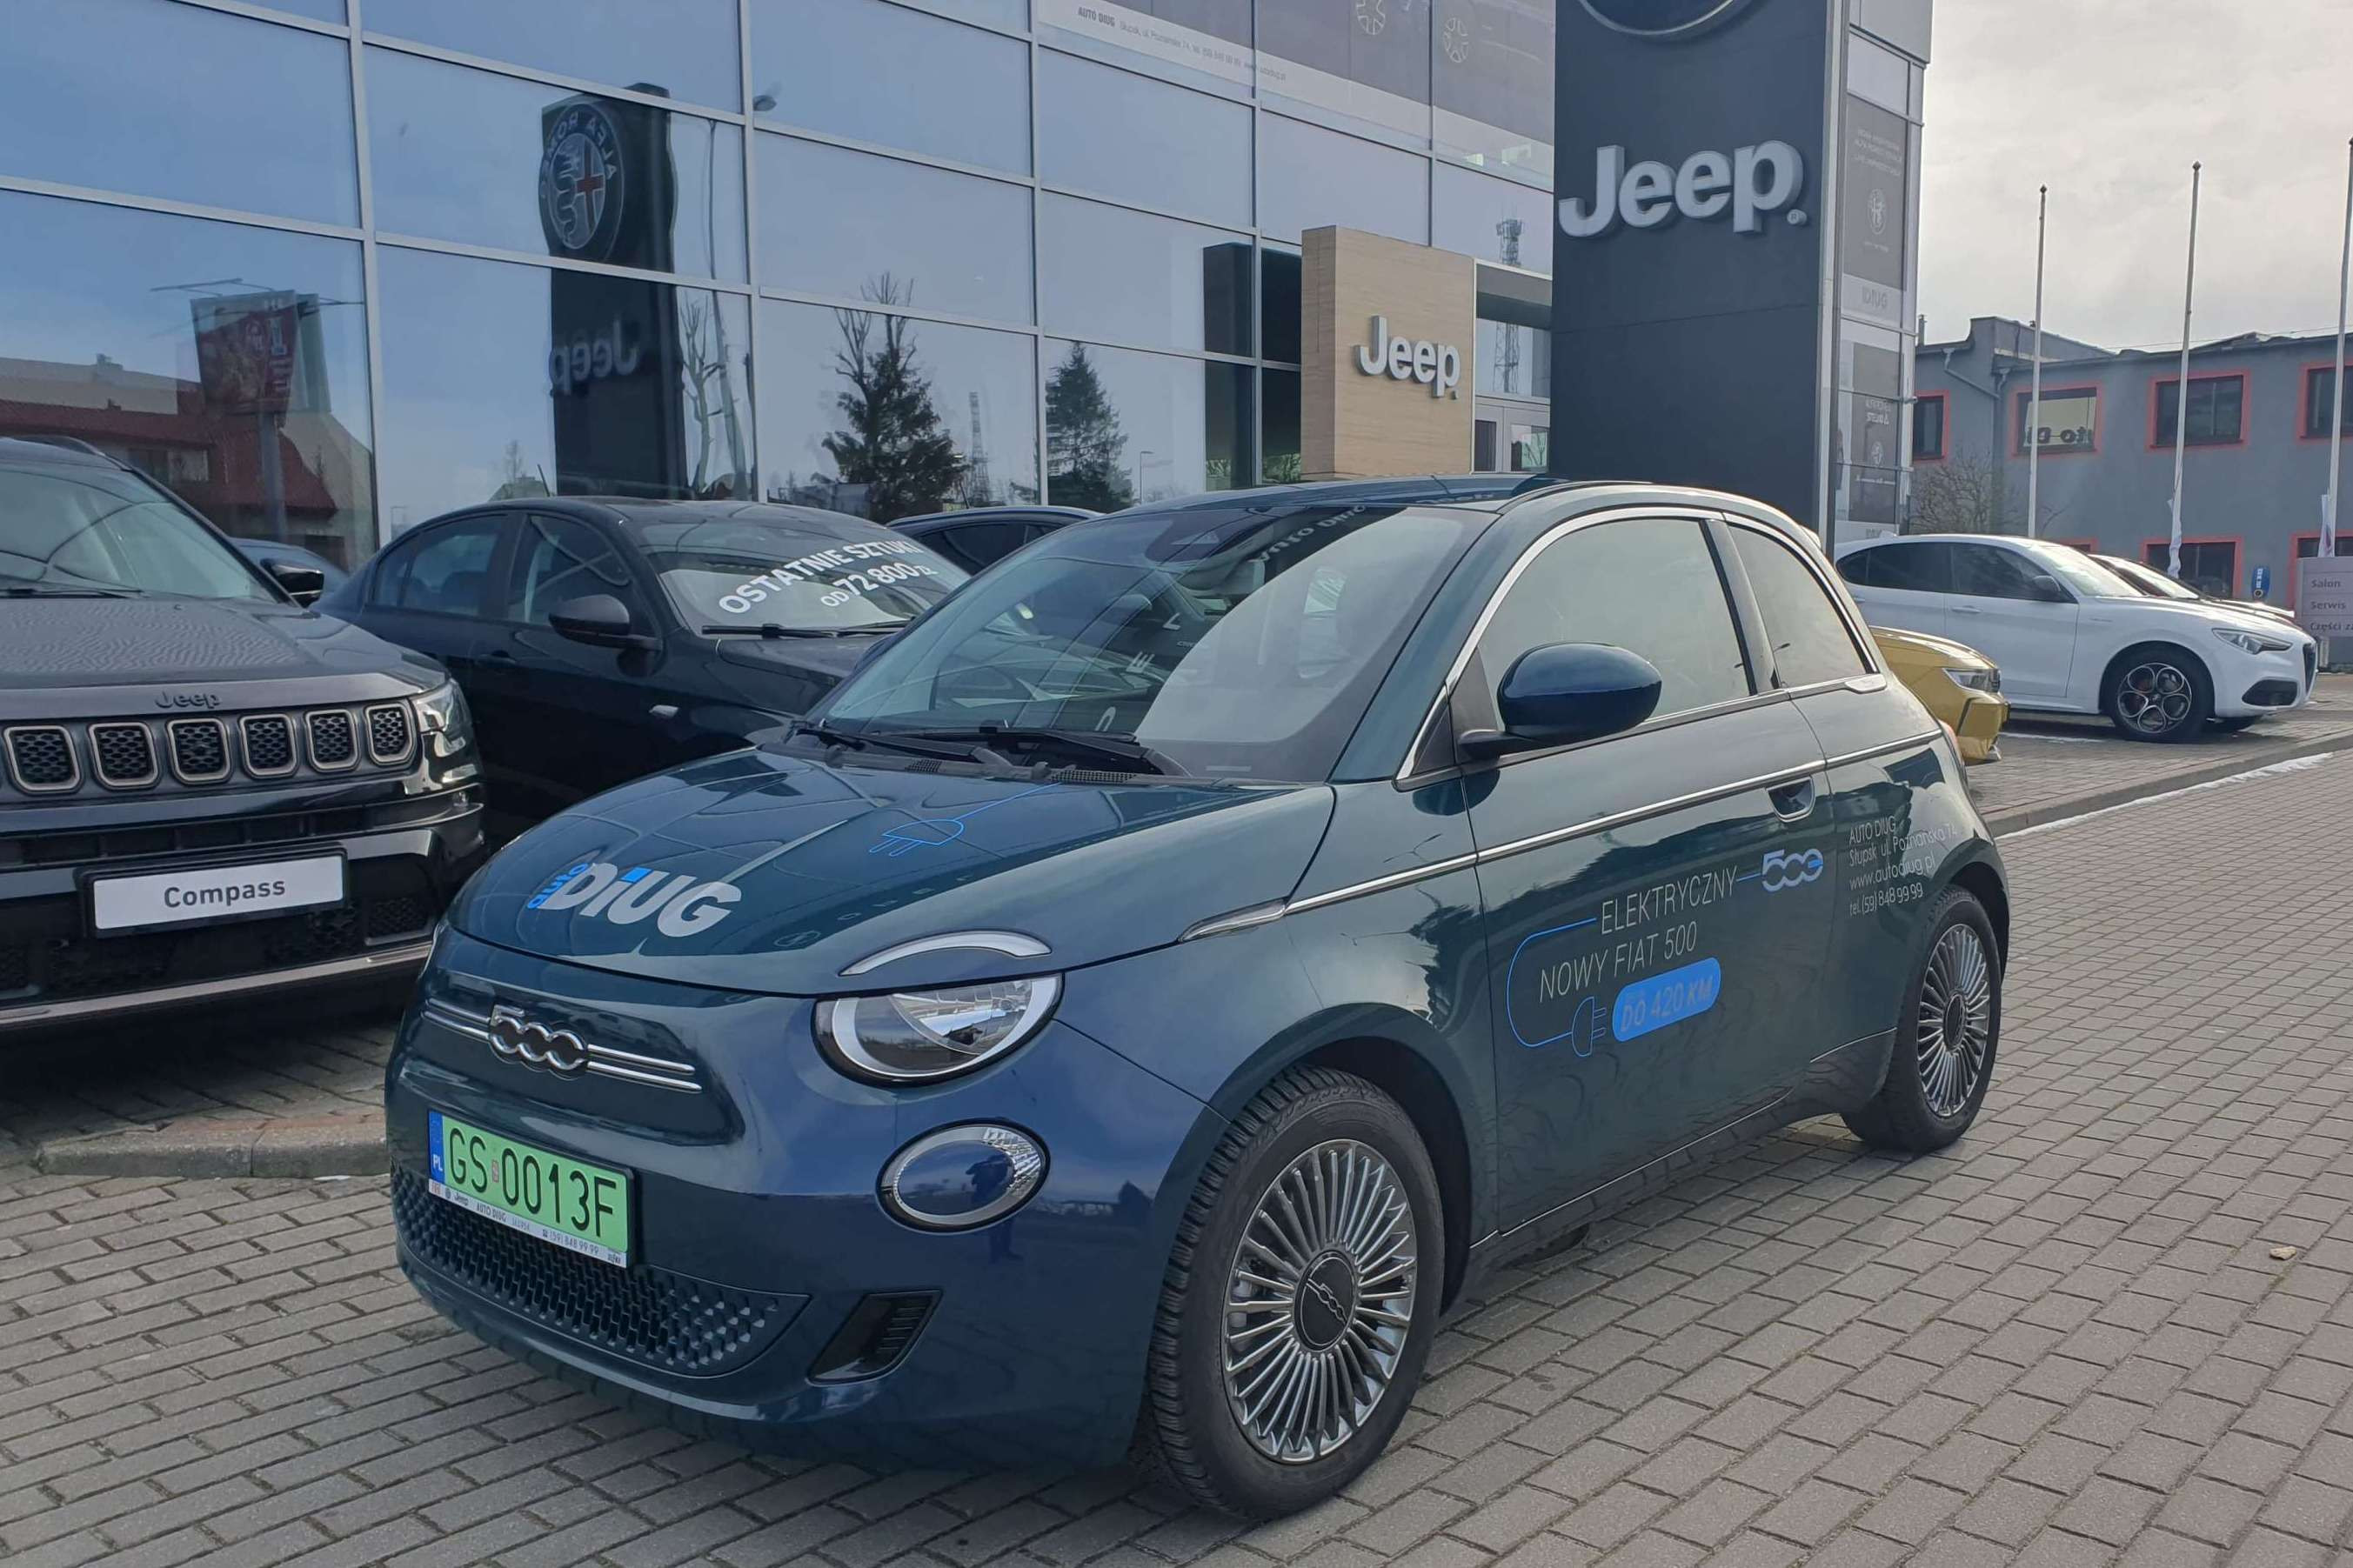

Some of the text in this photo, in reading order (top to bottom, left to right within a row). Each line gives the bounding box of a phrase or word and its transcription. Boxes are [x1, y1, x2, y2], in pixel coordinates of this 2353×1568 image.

[1558, 140, 1804, 238] Jeep
[1353, 315, 1461, 399] Jeep
[719, 540, 925, 614] OSTATNIE SZTUKI
[832, 574, 879, 596] 72
[866, 562, 920, 584] 800
[2310, 577, 2340, 588] Salon
[820, 591, 850, 607] OD
[2310, 601, 2346, 610] Serwis
[155, 691, 221, 710] Jeep
[1849, 822, 1873, 844] AUTO
[164, 879, 286, 910] Compass
[527, 862, 588, 910] auto
[1601, 865, 1737, 935] ELEKTRYCZNY
[1879, 886, 1896, 906] 848
[1896, 885, 1909, 903] 99
[1910, 882, 1923, 899] 99
[1539, 920, 1697, 1003] NOWY FIAT 500
[1620, 999, 1647, 1032] DO
[1651, 982, 1684, 1019] 420
[490, 1004, 585, 1071] 500
[432, 1153, 444, 1171] PL
[449, 1127, 617, 1238] GS 0013F
